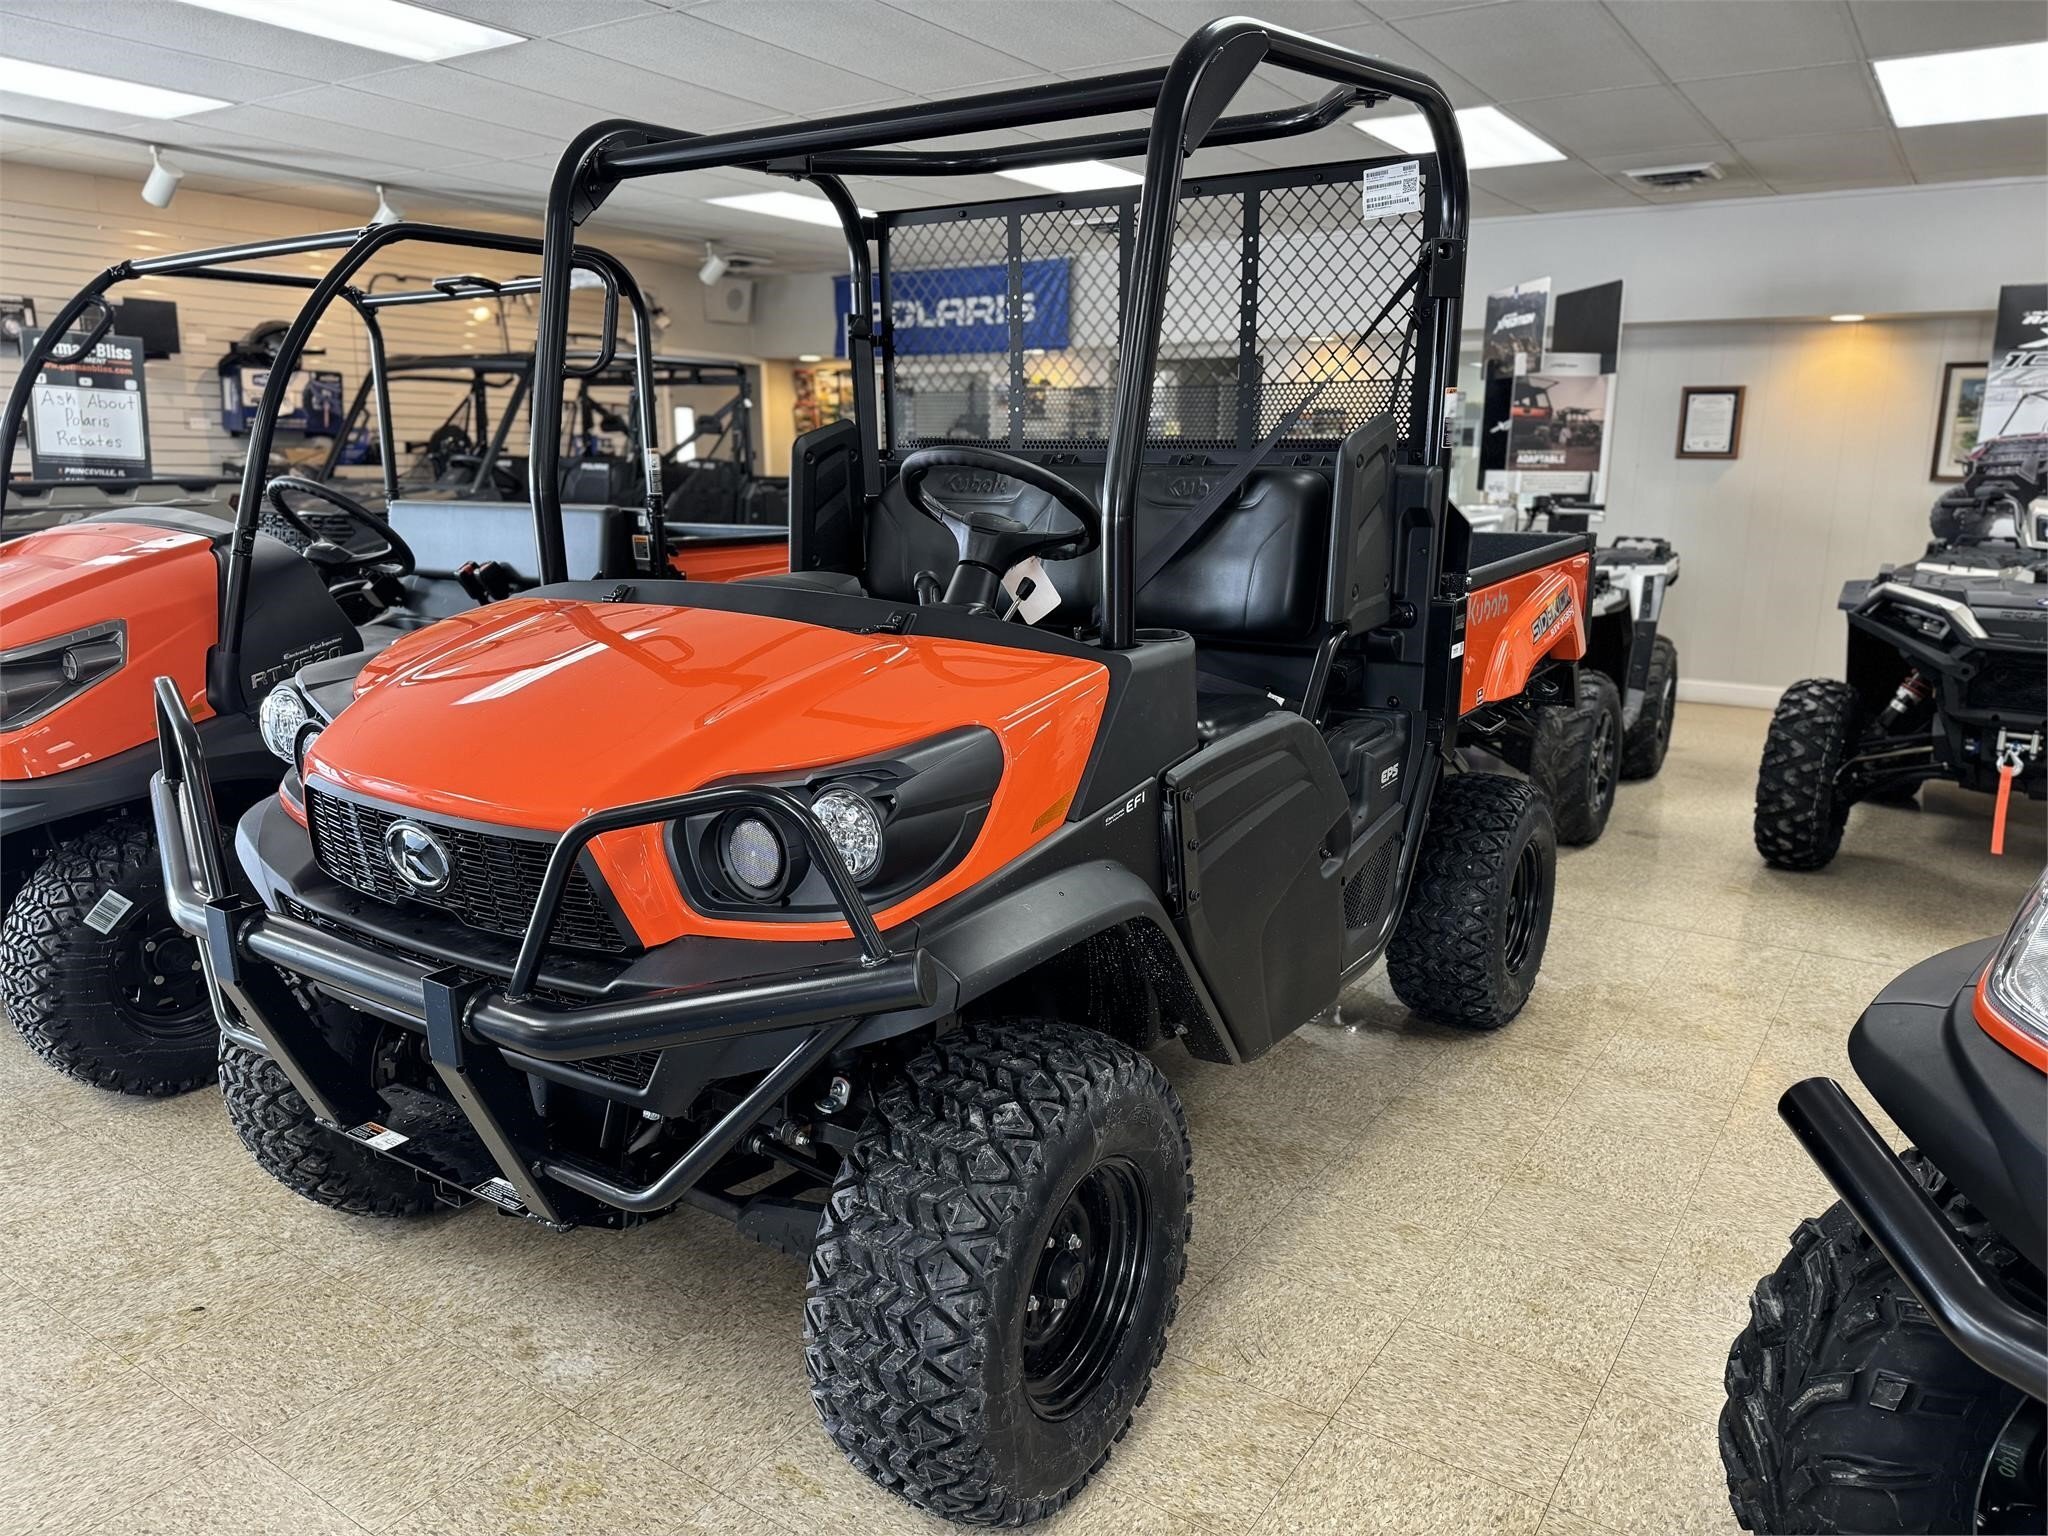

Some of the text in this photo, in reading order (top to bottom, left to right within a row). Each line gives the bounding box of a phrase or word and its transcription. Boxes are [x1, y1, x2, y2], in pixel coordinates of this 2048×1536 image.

[41, 390, 135, 410] Ask About
[65, 408, 110, 428] Polaris
[56, 431, 123, 449] Rebates
[64, 467, 117, 476] PRINCEVILLE,
[1467, 589, 1509, 626] Kubota
[1531, 585, 1572, 644] SIDEKICK
[1381, 762, 1399, 784] EPS
[1126, 790, 1145, 813] EFI
